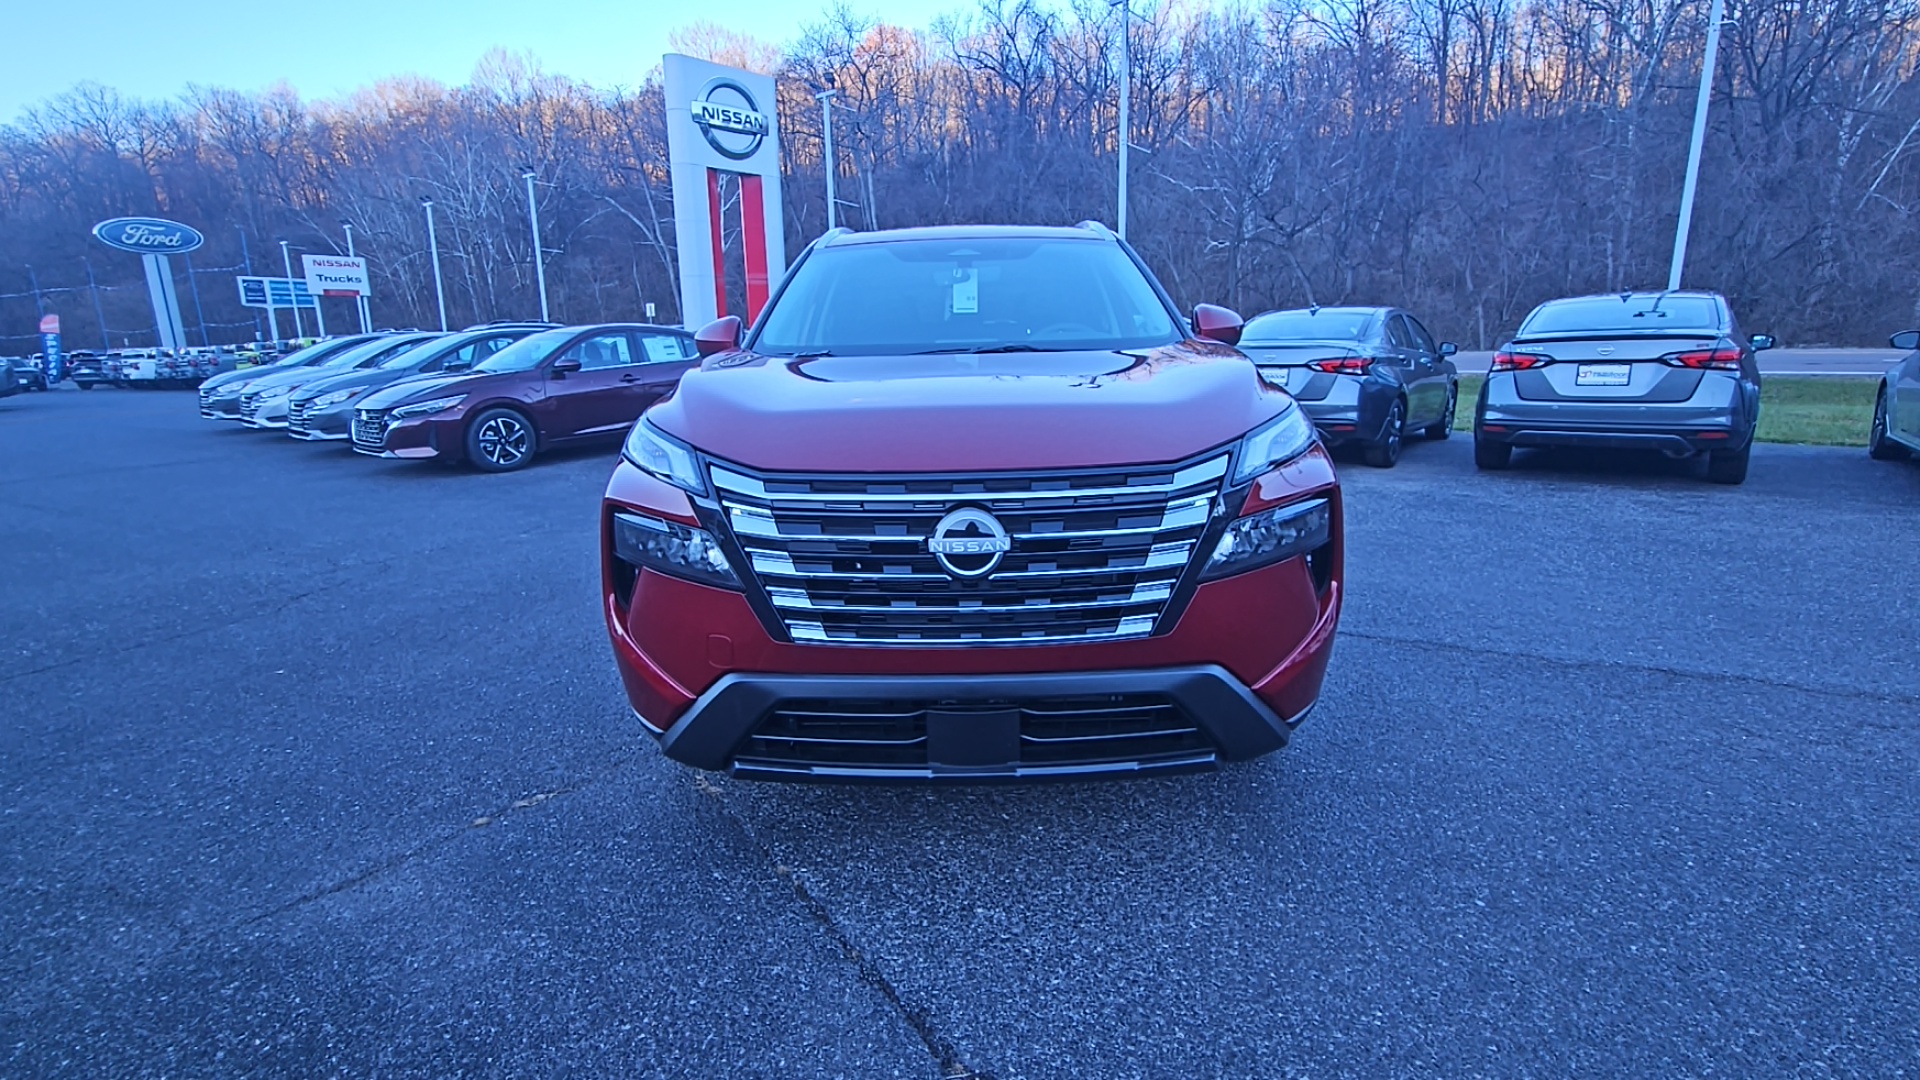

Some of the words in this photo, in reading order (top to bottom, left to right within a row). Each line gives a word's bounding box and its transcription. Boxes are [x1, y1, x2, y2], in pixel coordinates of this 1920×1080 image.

[702, 106, 763, 129] NISSAN
[121, 224, 182, 246] Ford
[312, 259, 361, 268] NISSAN
[316, 274, 362, 283] Trucks
[931, 540, 1008, 552] NISSAN
